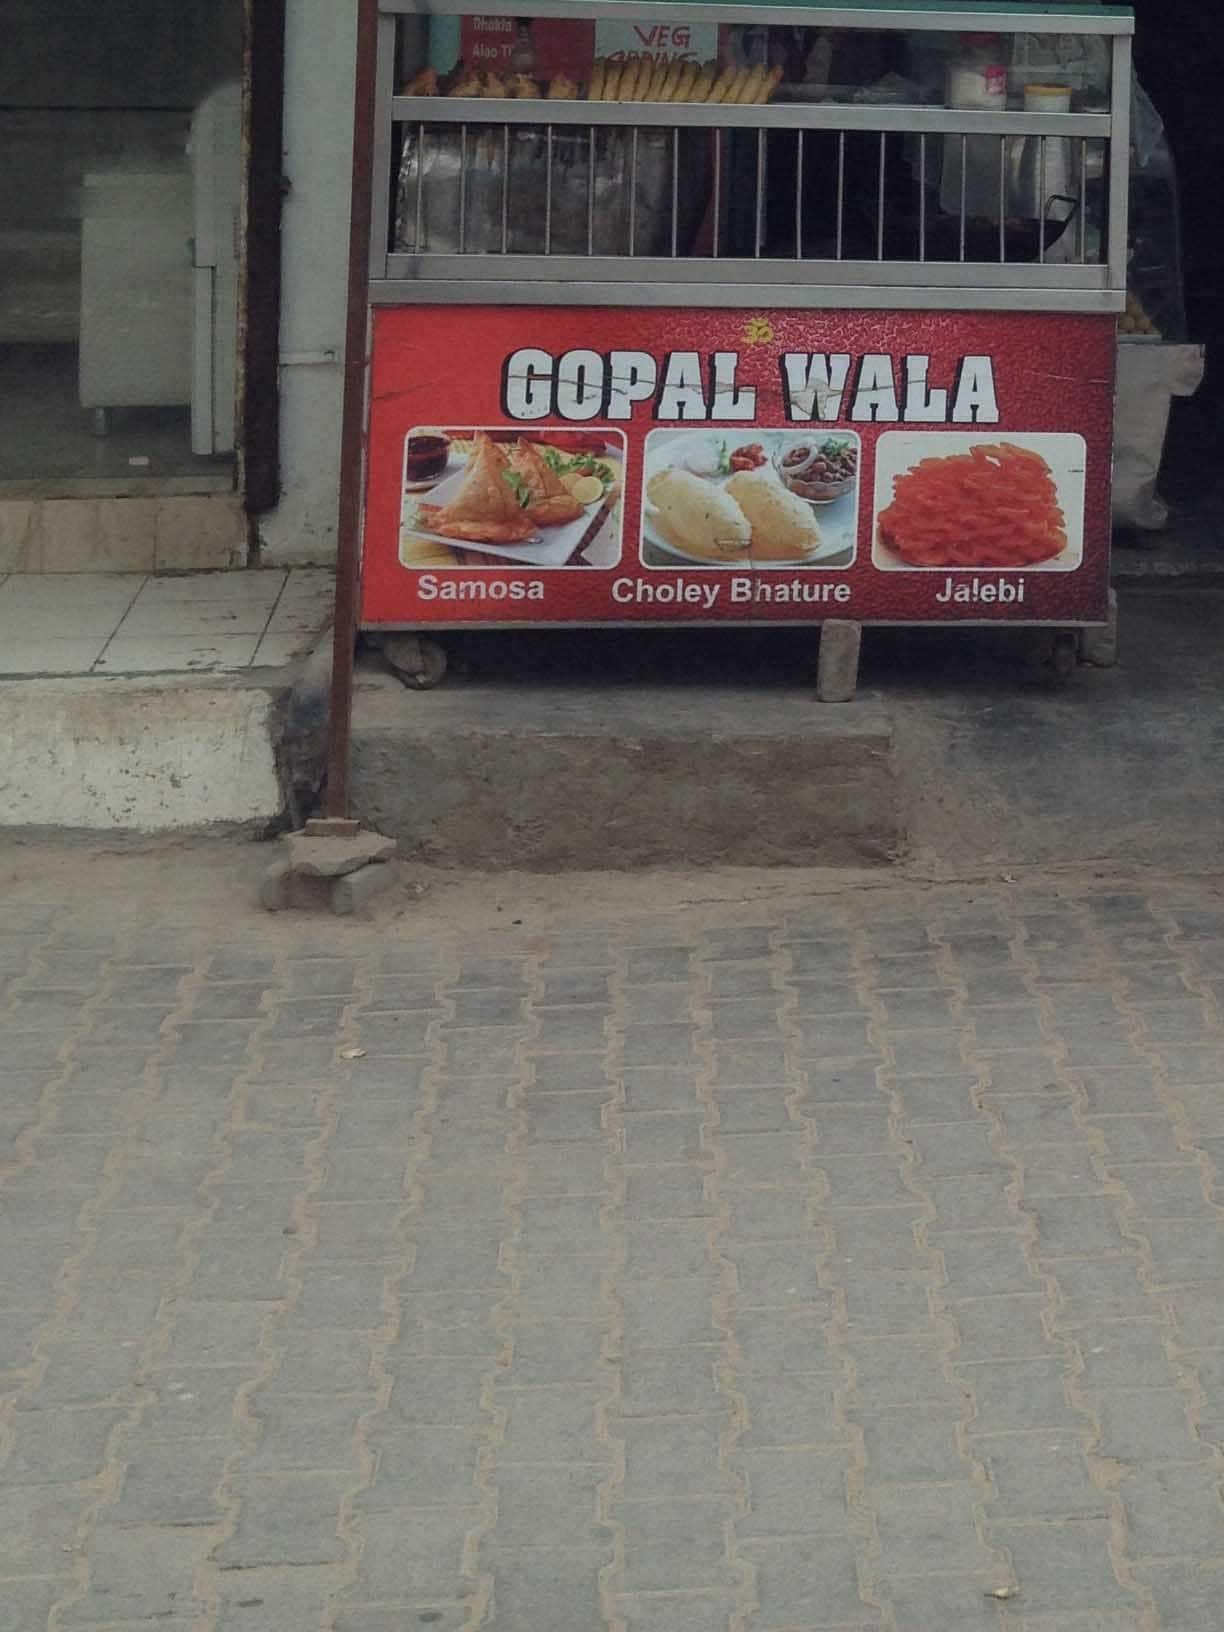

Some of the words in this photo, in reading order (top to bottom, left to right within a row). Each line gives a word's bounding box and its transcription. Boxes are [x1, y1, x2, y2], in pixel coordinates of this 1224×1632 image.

[633, 24, 691, 48] VEG
[501, 347, 757, 422] GOPAL
[779, 348, 1001, 423] WALA
[417, 574, 545, 602] Samosa
[611, 577, 720, 608] Choley
[730, 577, 852, 604] Bhature
[935, 576, 1025, 604] Jalebi
